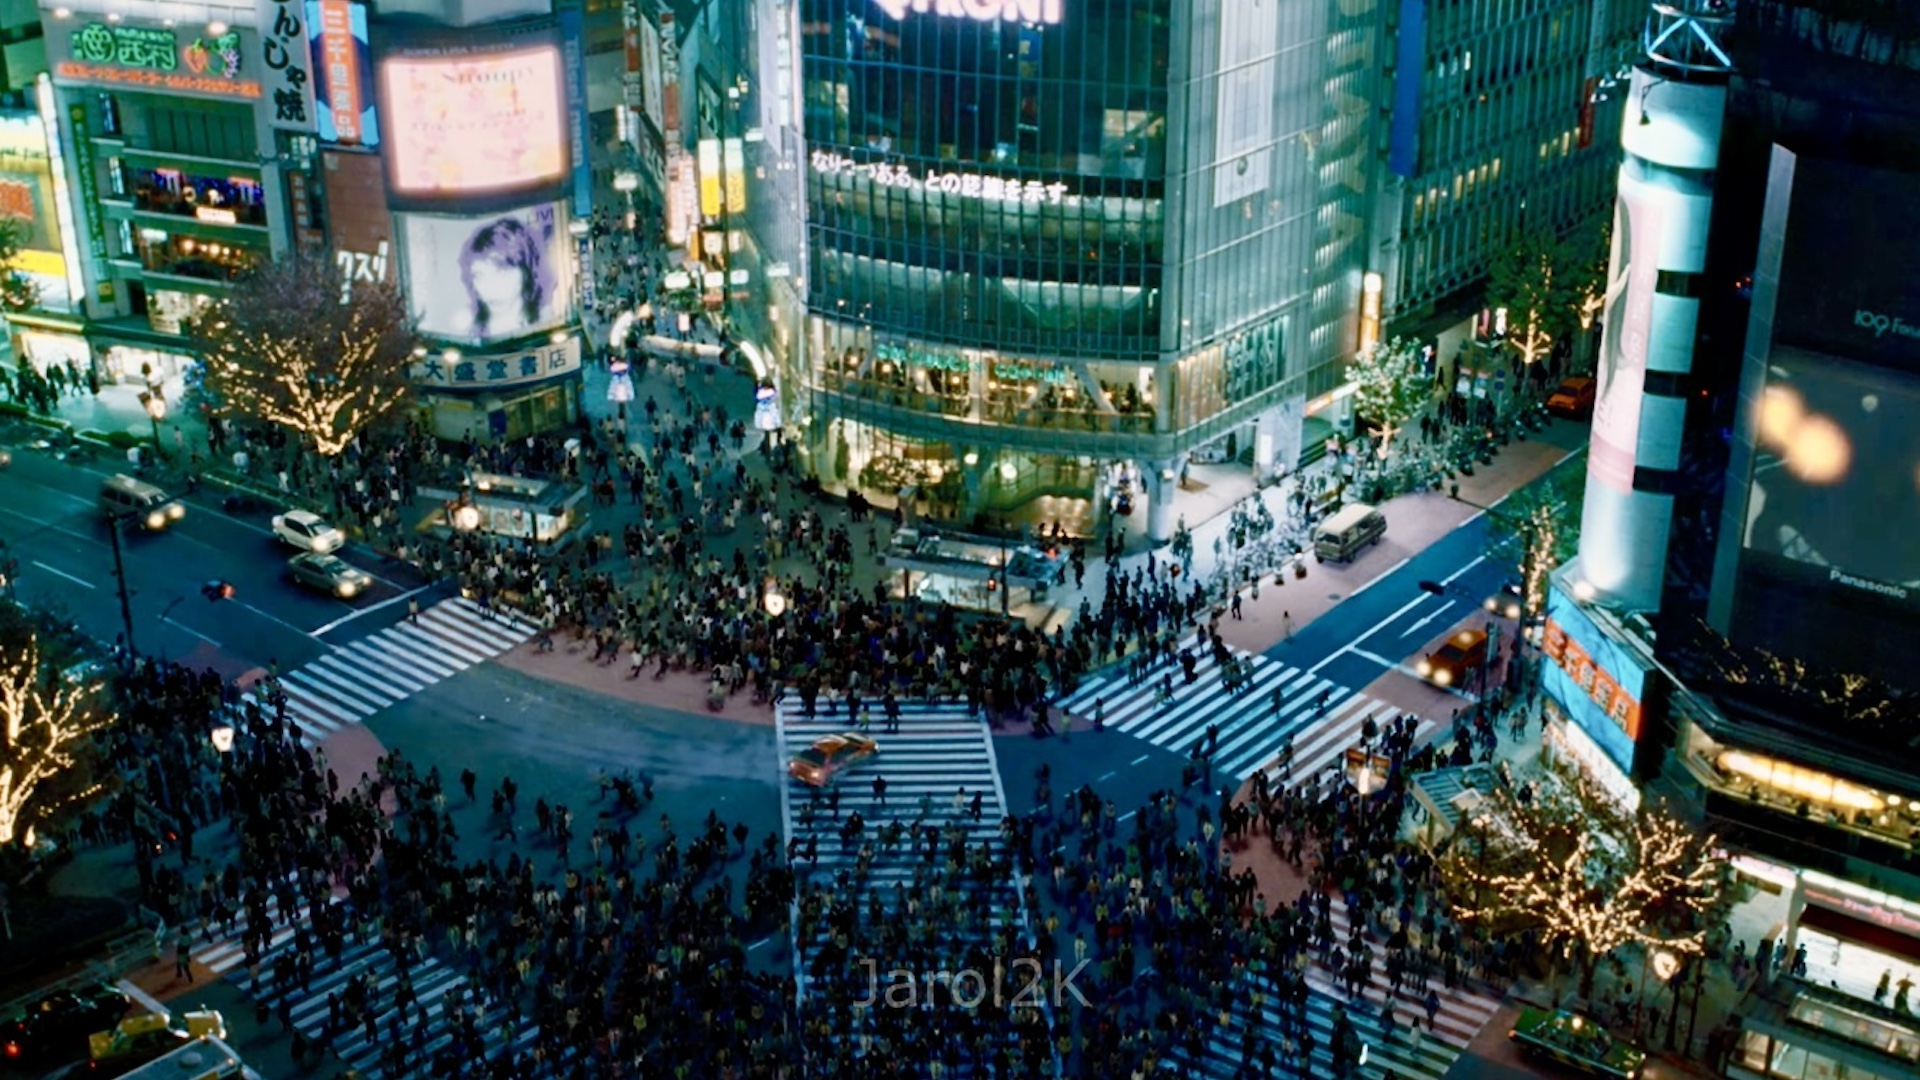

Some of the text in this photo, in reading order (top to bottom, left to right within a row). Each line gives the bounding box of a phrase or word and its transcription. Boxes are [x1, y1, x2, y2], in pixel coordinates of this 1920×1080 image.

[263, 0, 307, 122] んじゃ焼
[1855, 309, 1890, 338] 109
[1829, 569, 1908, 599] Panasonic
